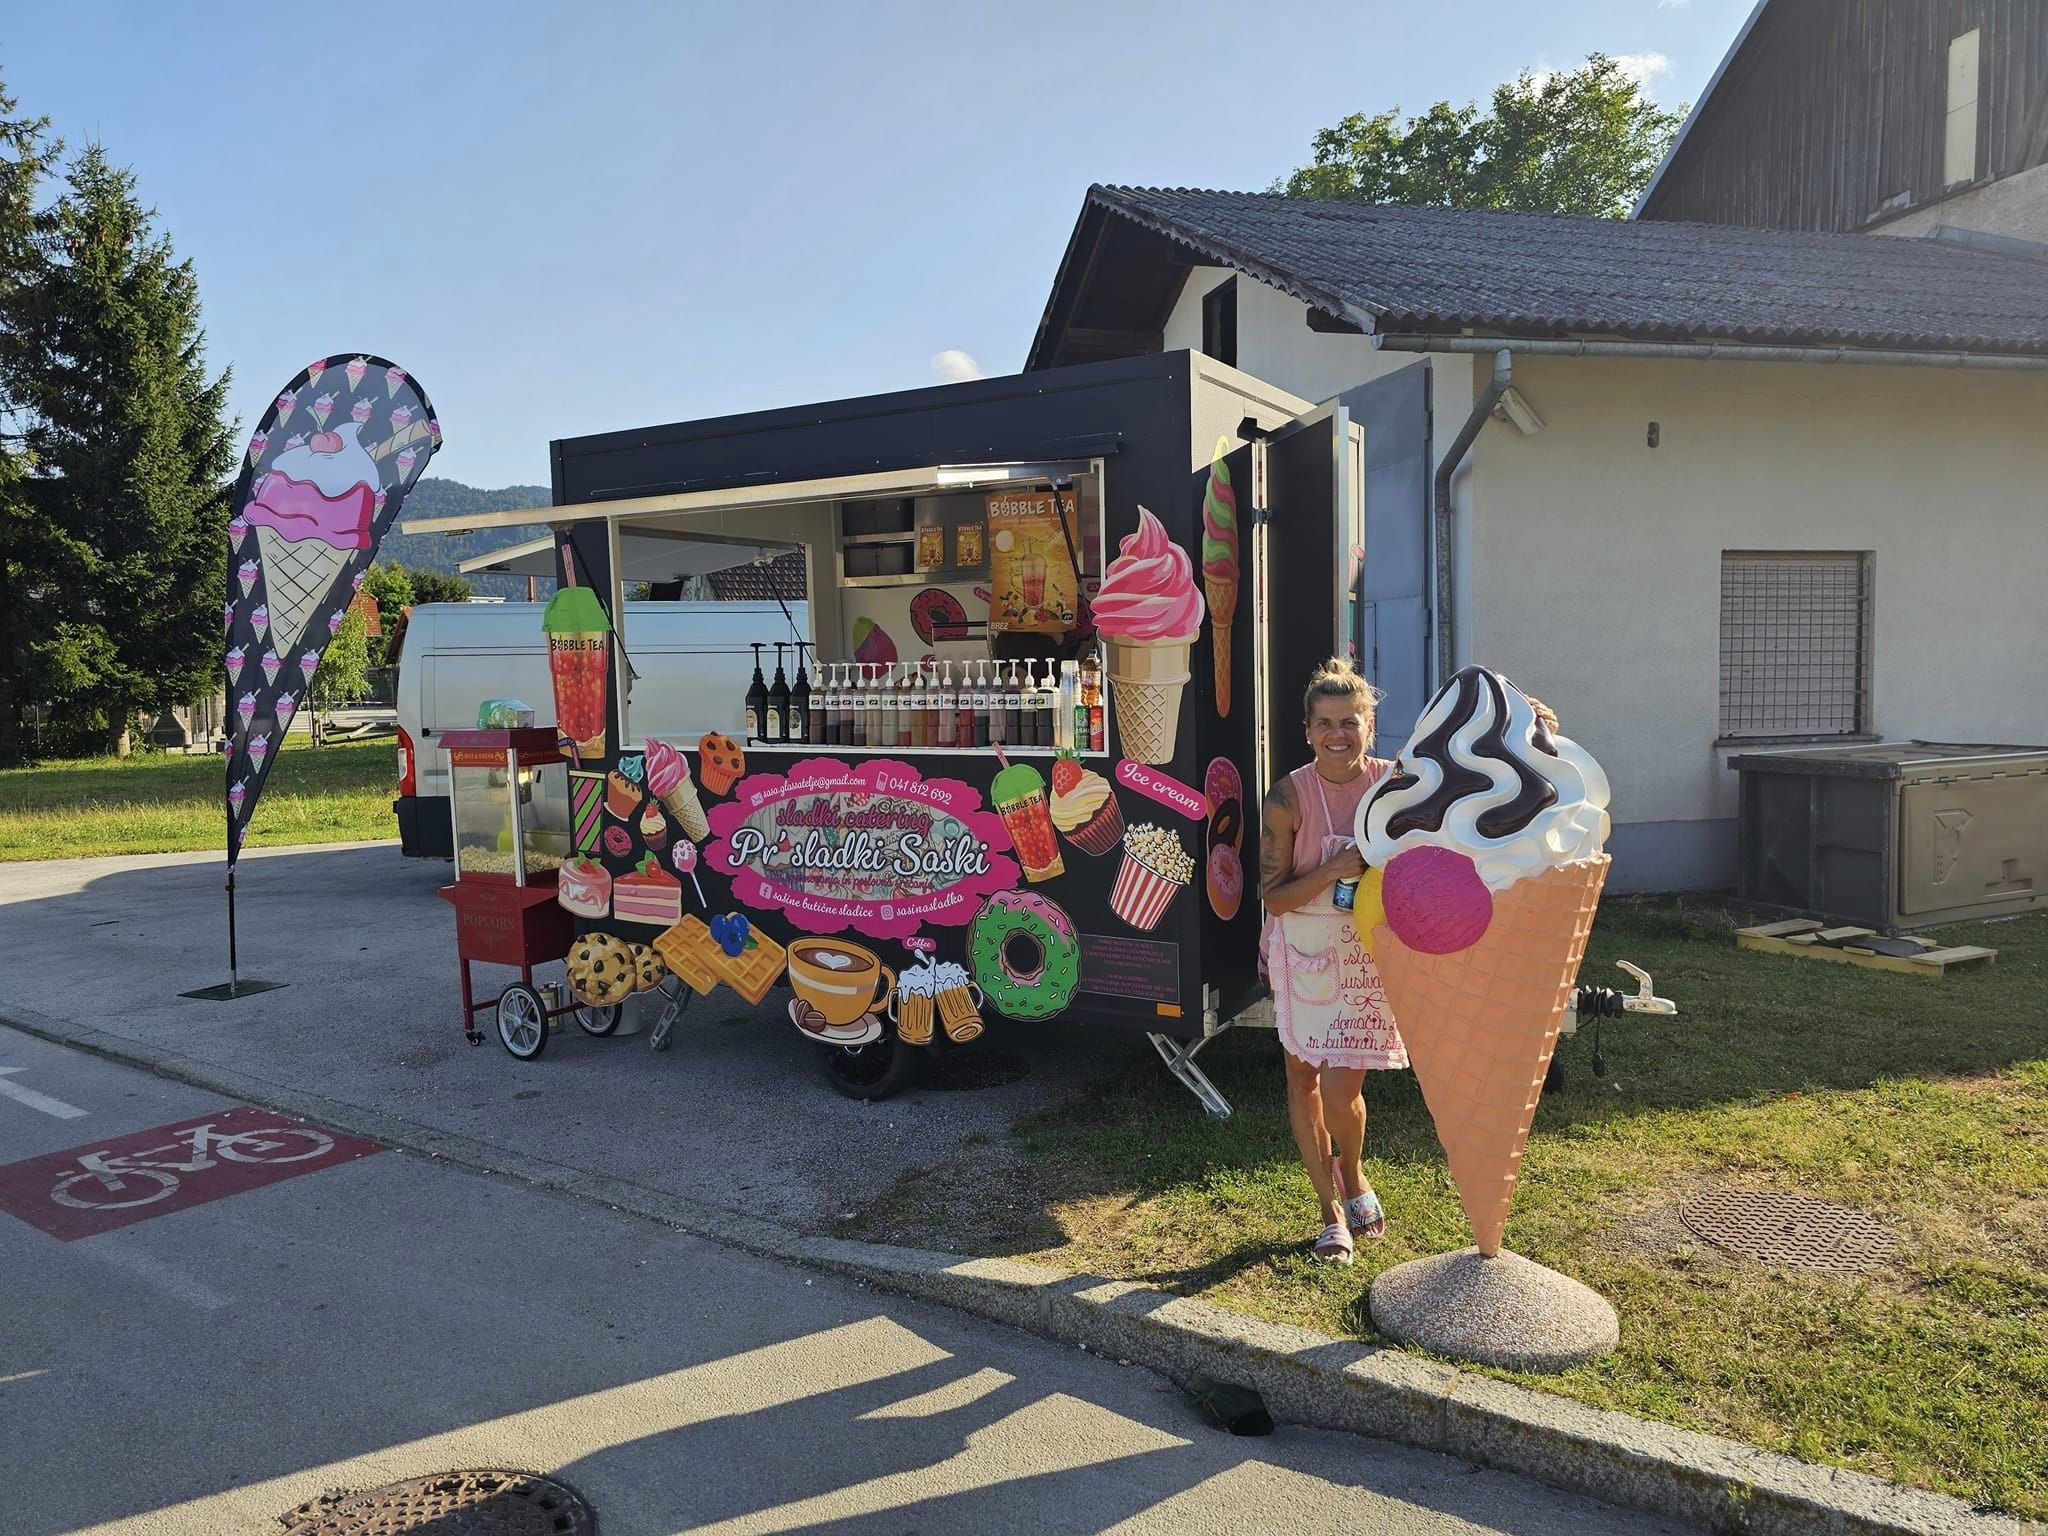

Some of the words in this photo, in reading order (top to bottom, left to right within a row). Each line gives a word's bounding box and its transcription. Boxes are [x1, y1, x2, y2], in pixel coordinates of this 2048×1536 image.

[990, 496, 1045, 517] BUBBLE
[551, 636, 586, 651] BUBBLE
[588, 639, 604, 651] TEA
[889, 777, 908, 790] 041
[910, 781, 928, 797] 812
[930, 788, 952, 805] 692
[1123, 763, 1150, 785] Ice
[1152, 782, 1200, 811] cream
[1000, 799, 1029, 816] BUBBLE
[1030, 794, 1043, 806] TEA
[776, 799, 841, 827] sladki
[844, 803, 934, 840] catering
[791, 830, 886, 870] sladki
[892, 834, 991, 876] Saški
[802, 898, 838, 915] butične
[838, 905, 874, 917] sladice
[463, 912, 515, 929] POPCORN
[906, 937, 932, 949] Coffee
[1329, 1010, 1387, 1030] domačih
[1306, 1036, 1319, 1049] in
